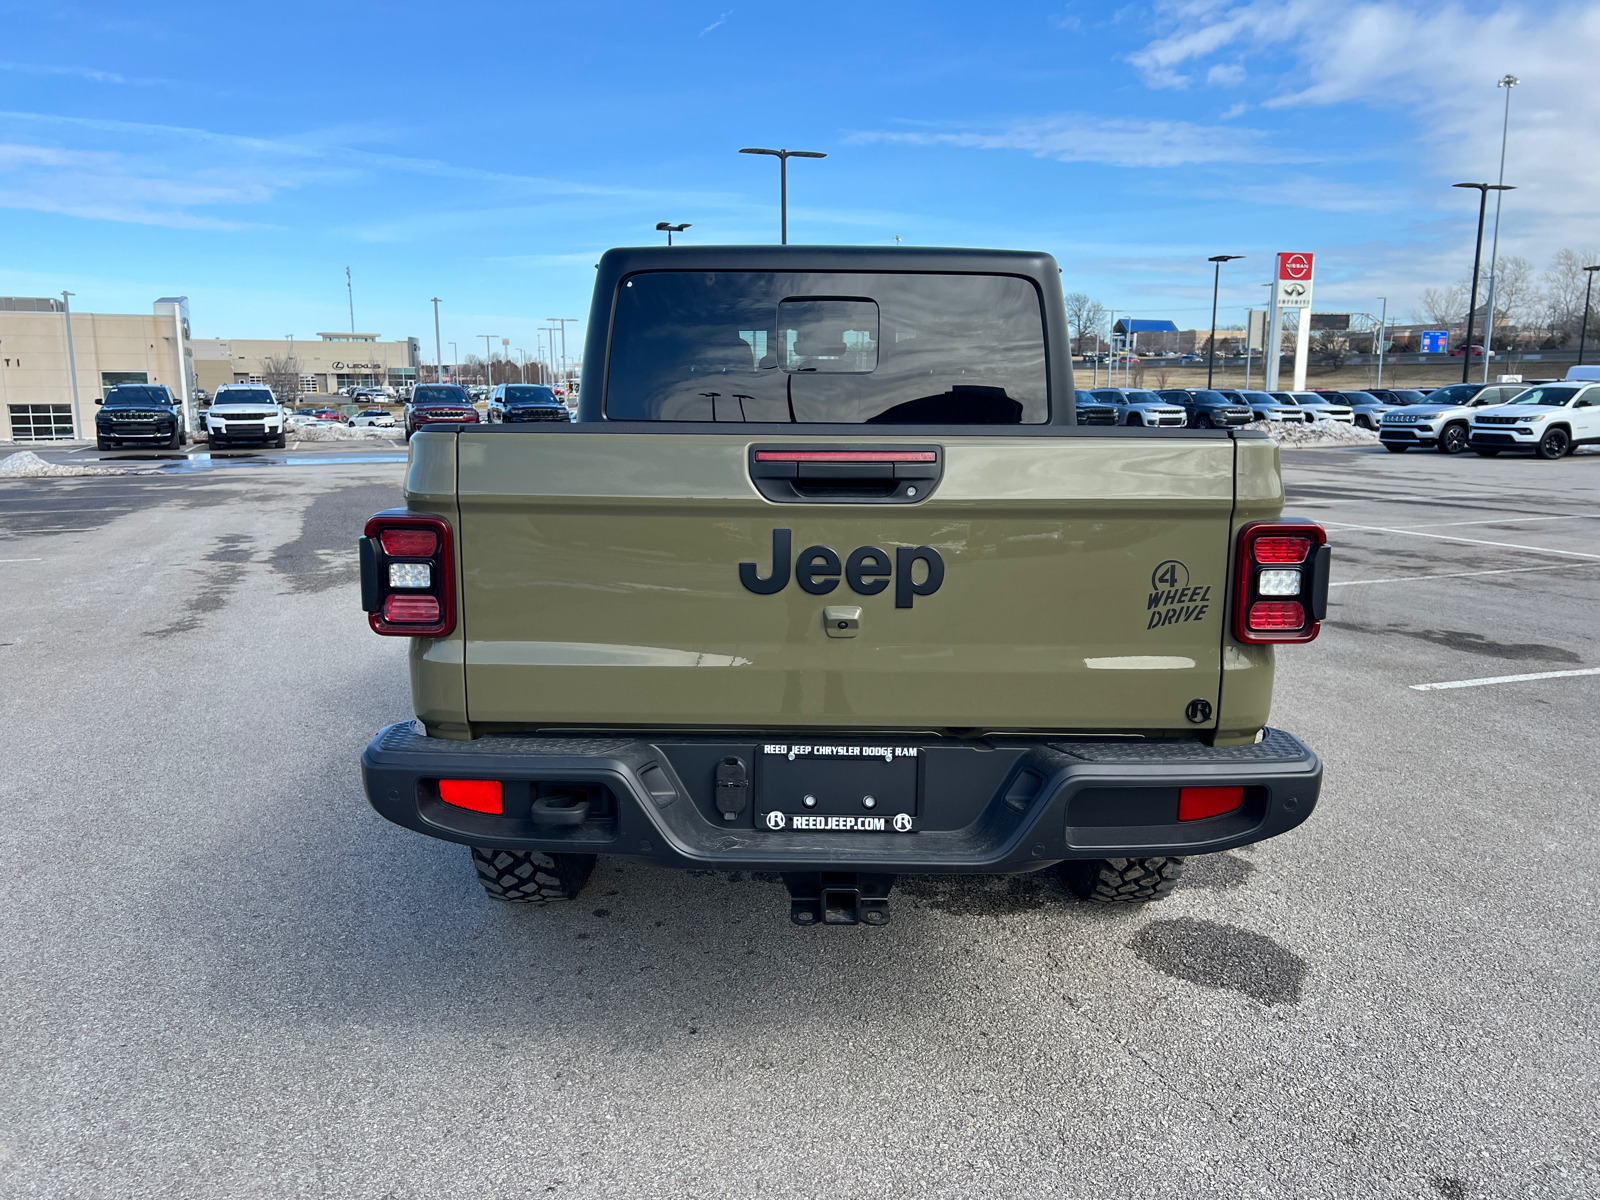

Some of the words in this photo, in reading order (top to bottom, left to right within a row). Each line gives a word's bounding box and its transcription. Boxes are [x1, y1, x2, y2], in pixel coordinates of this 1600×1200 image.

[739, 528, 945, 609] Jeep
[1158, 564, 1178, 588] 4
[1147, 585, 1212, 610] WHEEL
[1147, 604, 1209, 630] DRIVE
[764, 744, 787, 754] REED
[790, 745, 811, 755] JEEP
[814, 746, 860, 756] CHRYSLER
[863, 746, 893, 757] DODGE
[895, 747, 918, 757] RAM
[793, 816, 885, 830] REEDJEEP.COM
